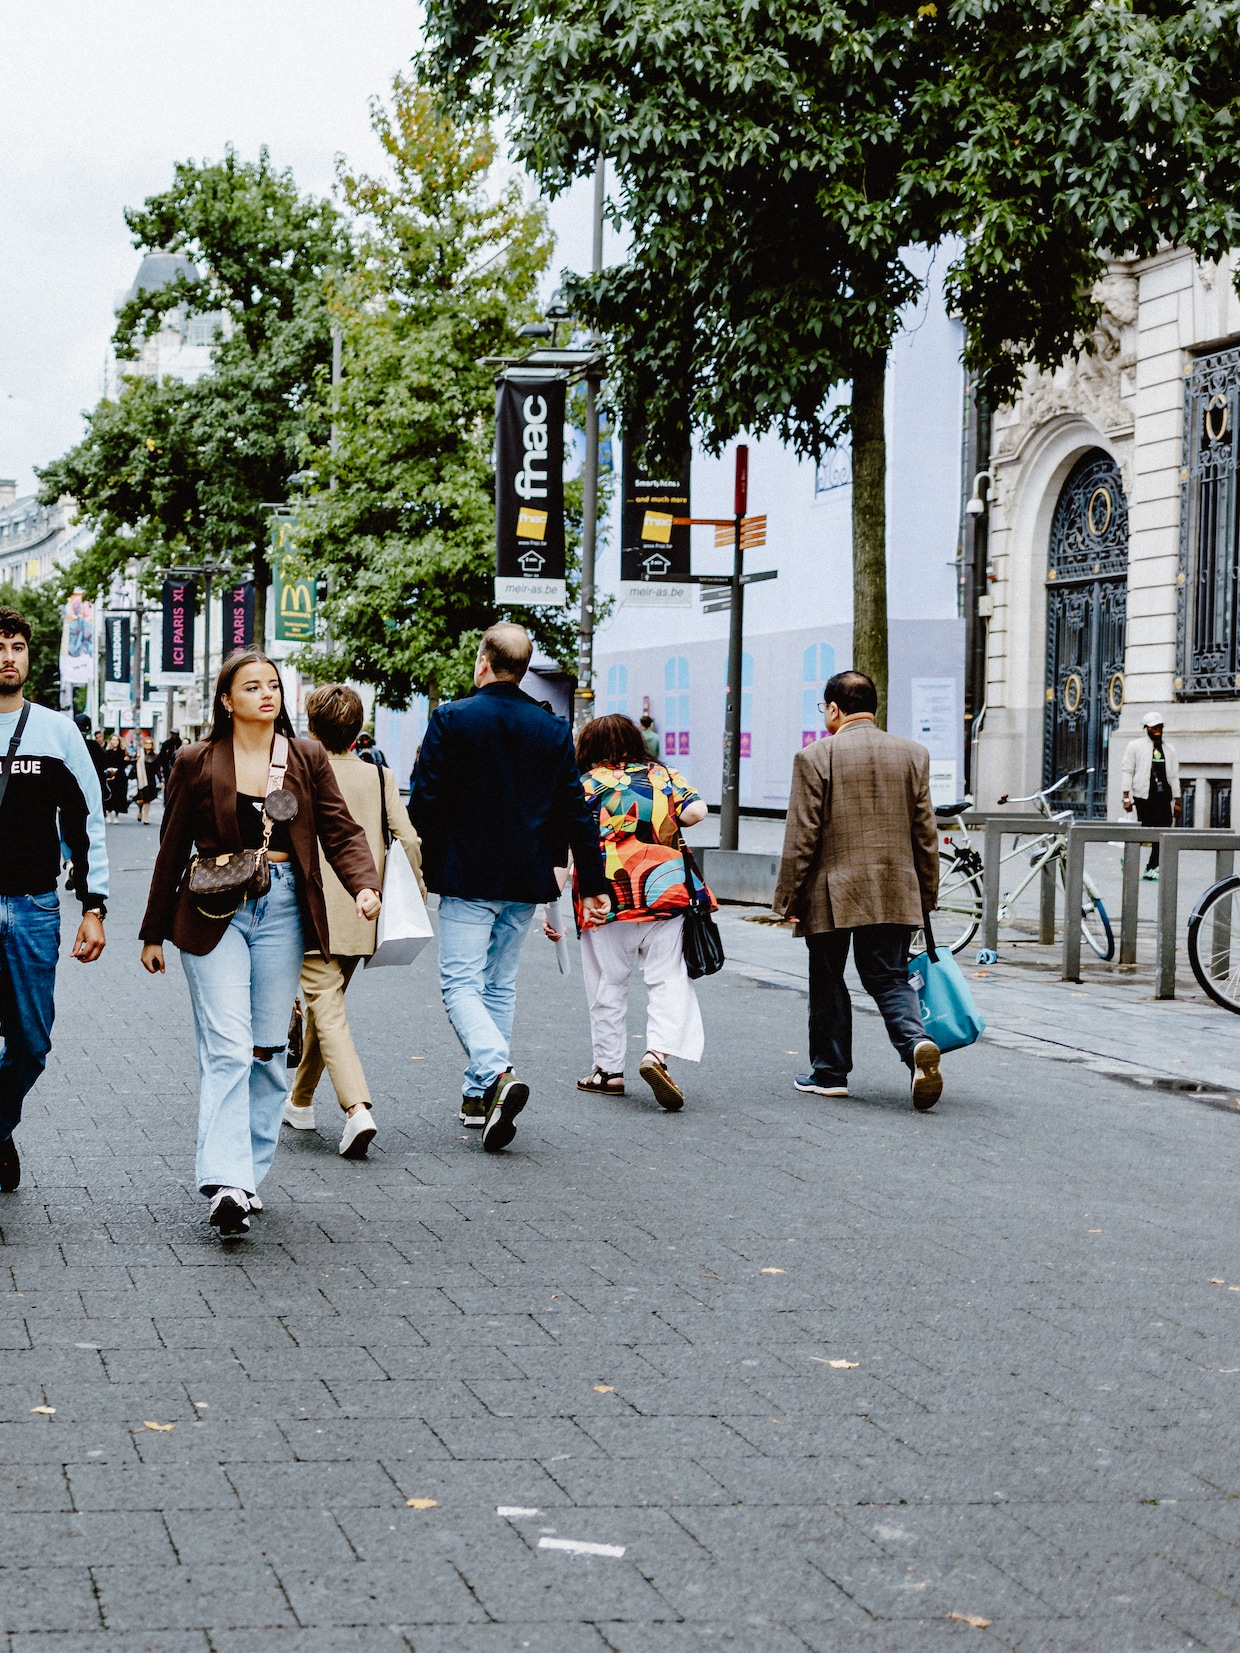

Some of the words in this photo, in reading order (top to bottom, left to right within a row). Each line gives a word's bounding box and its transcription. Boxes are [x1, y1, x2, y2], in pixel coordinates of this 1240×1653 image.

[514, 394, 548, 500] fnac
[173, 586, 184, 602] XL
[233, 587, 244, 603] XL
[505, 583, 558, 594] meir-as.be
[629, 586, 684, 597] meir-as.be
[173, 607, 184, 644] PARIS
[233, 608, 244, 644] PARIS
[173, 647, 184, 665] ICI
